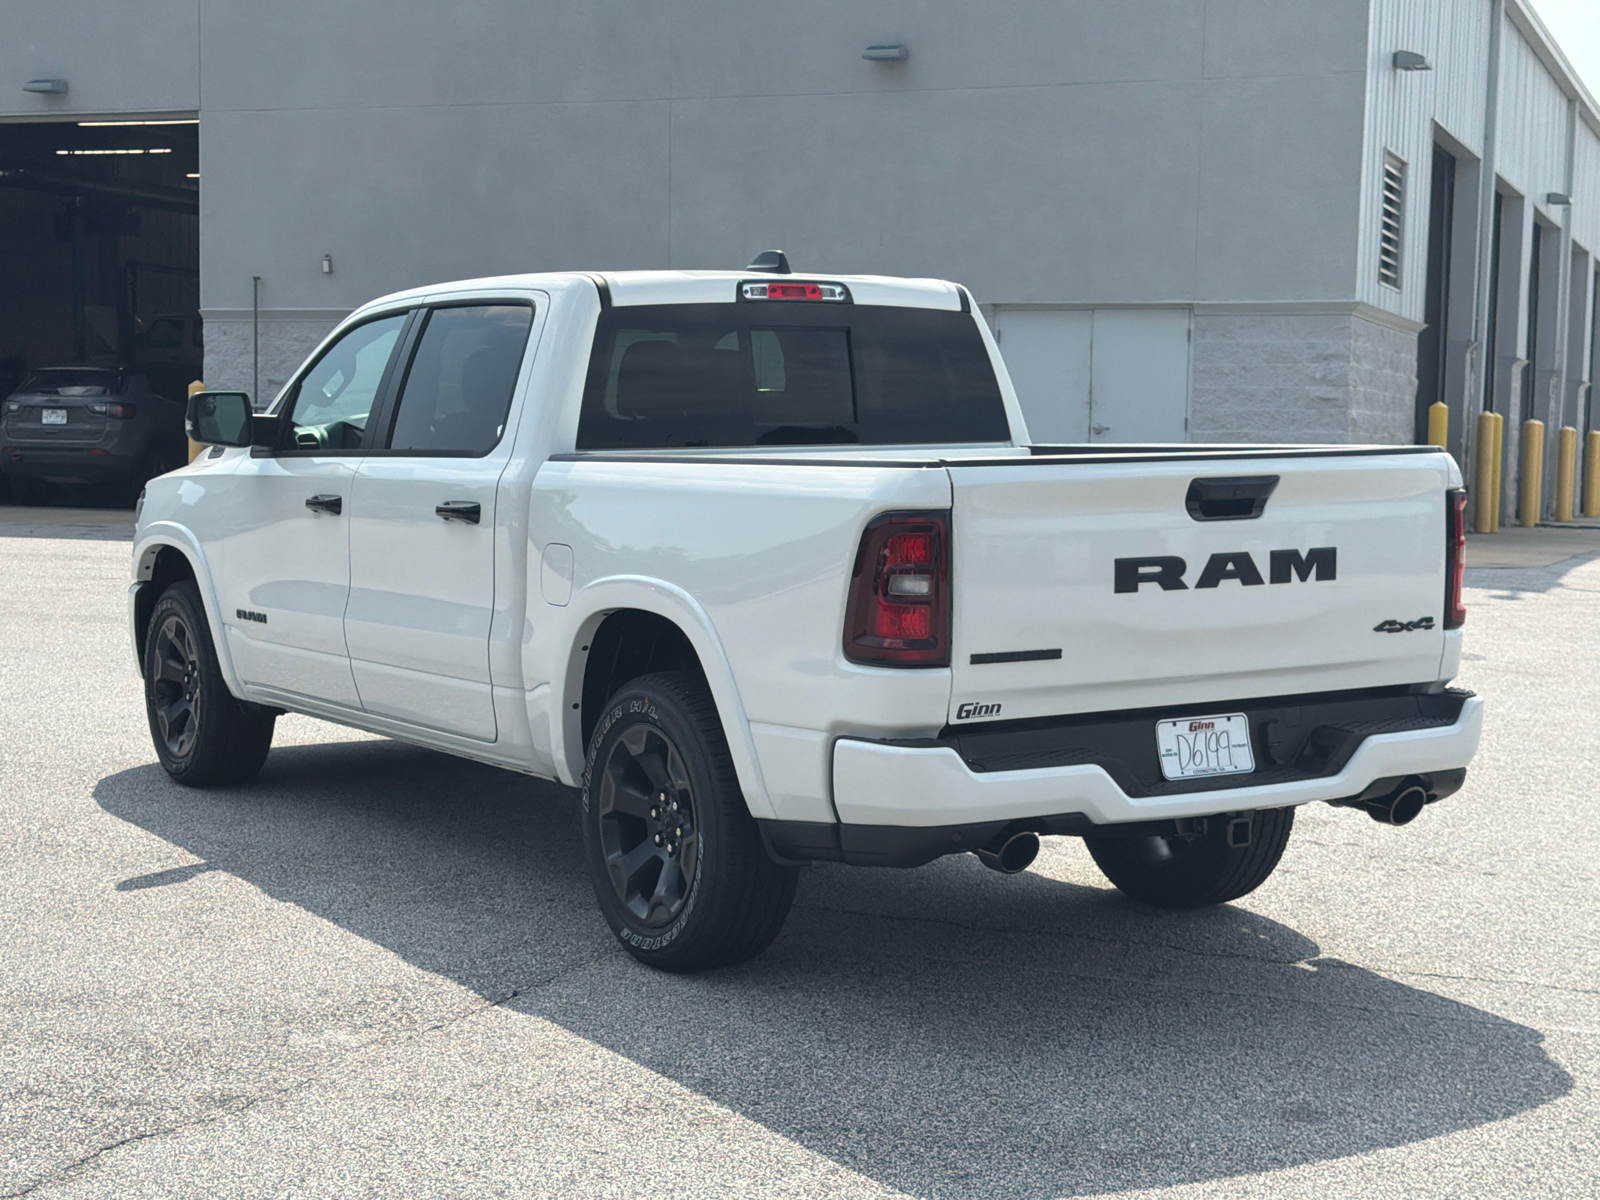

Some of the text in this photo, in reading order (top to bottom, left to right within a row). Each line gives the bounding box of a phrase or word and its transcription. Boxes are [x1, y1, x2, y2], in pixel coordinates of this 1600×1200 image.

[1114, 547, 1337, 593] RAM
[236, 609, 267, 624] RAM
[1373, 616, 1435, 633] 4x4
[956, 701, 1002, 720] Ginn
[1189, 721, 1215, 732] Ginn
